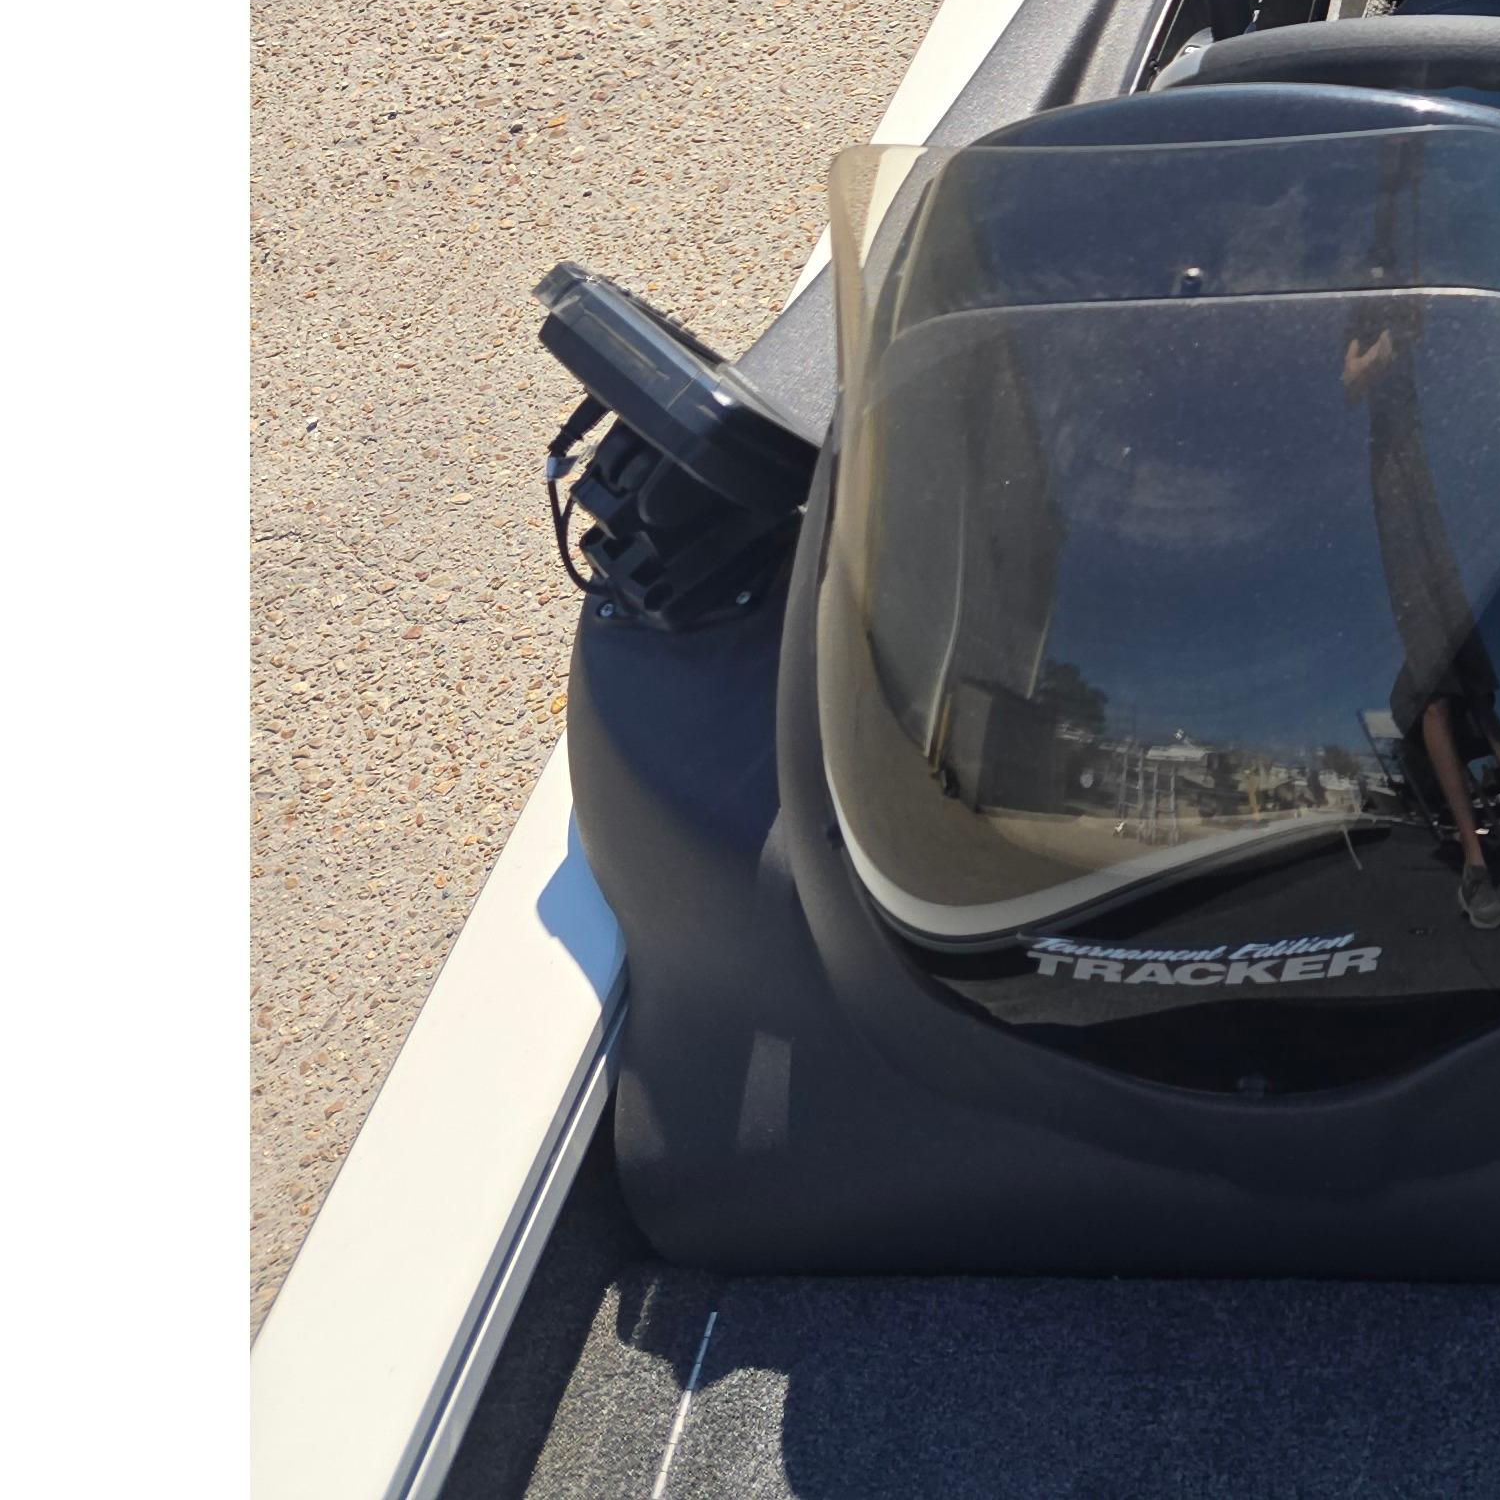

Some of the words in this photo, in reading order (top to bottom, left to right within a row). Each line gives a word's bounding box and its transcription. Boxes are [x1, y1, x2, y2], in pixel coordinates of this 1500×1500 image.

[1032, 937, 1228, 962] Tournament
[1229, 931, 1355, 960] Edition
[1028, 946, 1382, 986] TRACKER
